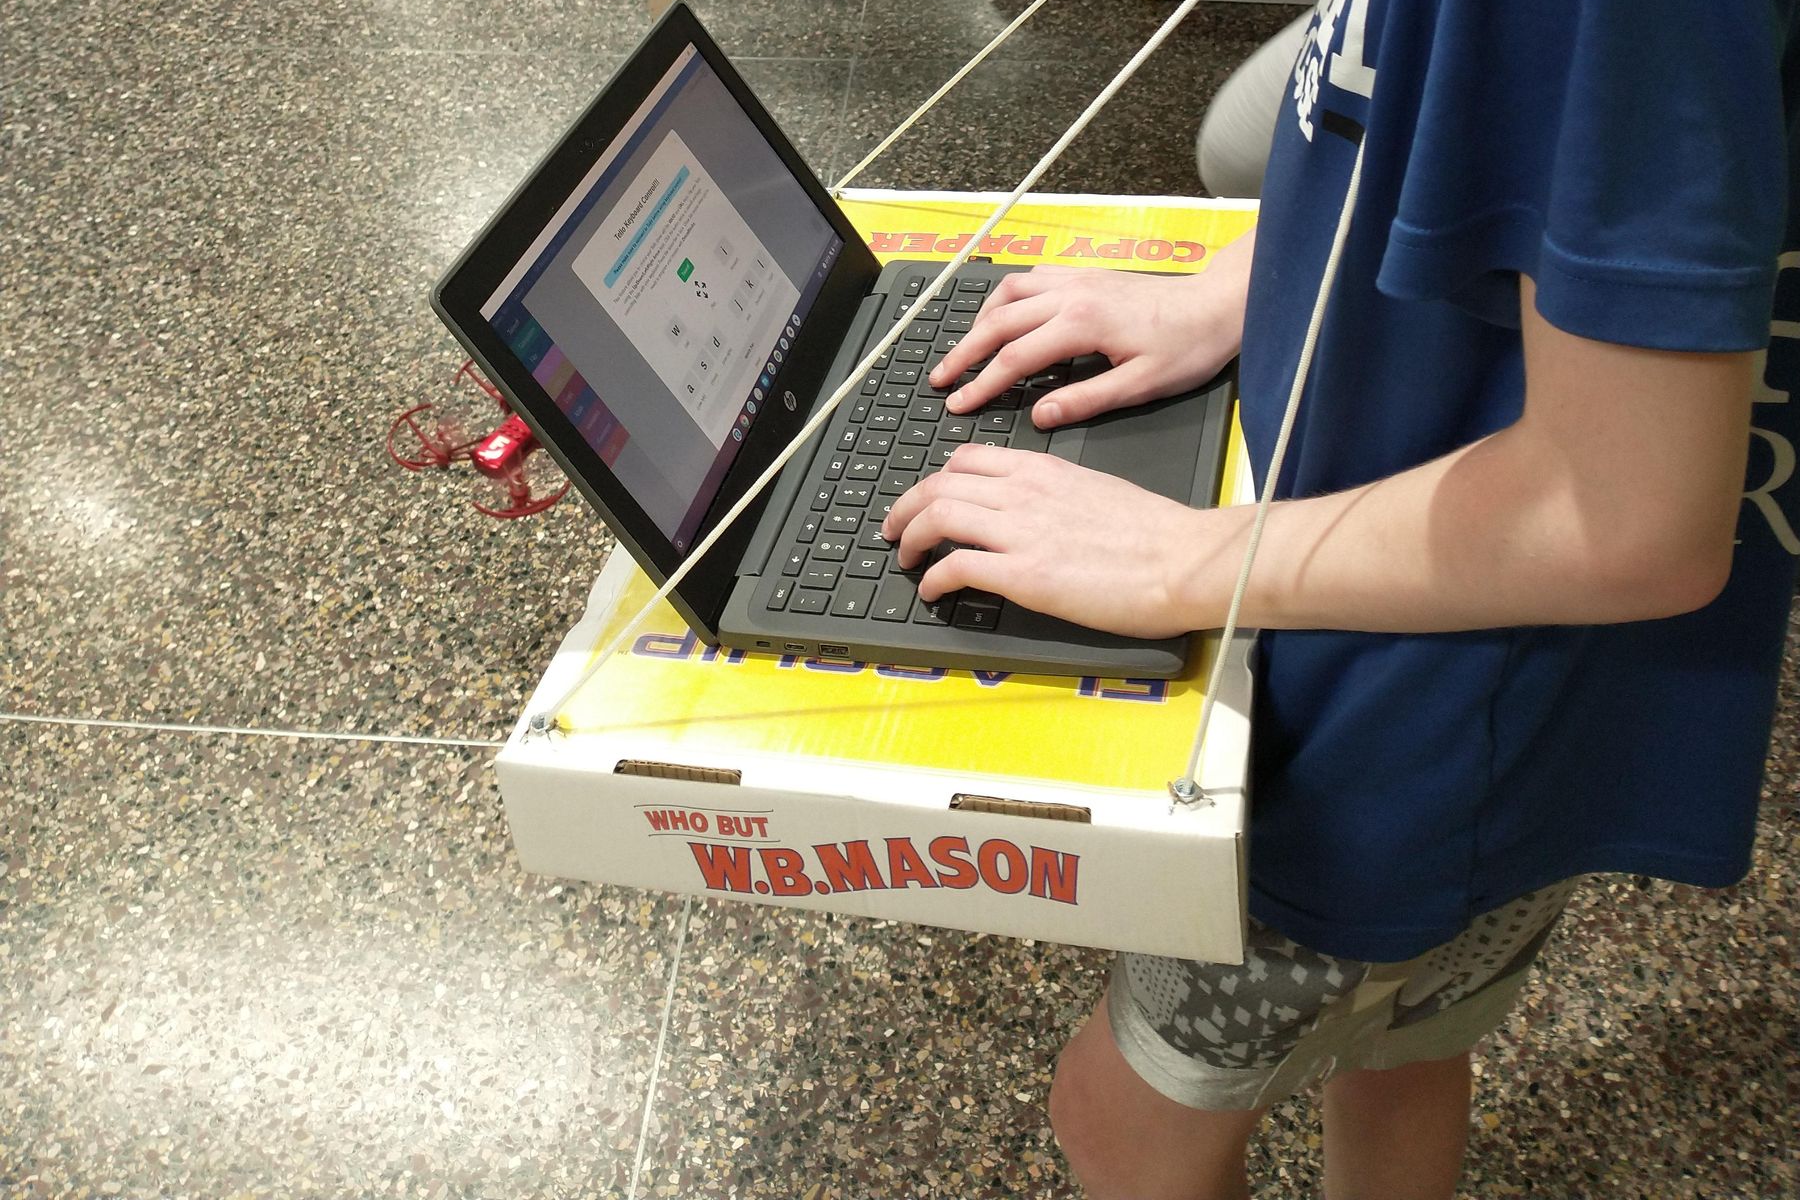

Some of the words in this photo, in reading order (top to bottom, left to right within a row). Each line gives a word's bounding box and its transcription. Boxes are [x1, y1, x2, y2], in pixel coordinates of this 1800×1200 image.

[614, 224, 626, 241] Tello
[624, 199, 644, 230] Keyboard
[870, 231, 1047, 257] PAPER
[1056, 236, 1206, 263] COPY
[861, 560, 876, 568] q
[776, 588, 785, 598] esc
[846, 600, 856, 610] tab
[643, 809, 708, 834] WHO
[716, 814, 769, 839] BUT
[686, 835, 1081, 906] W.B.MASON
